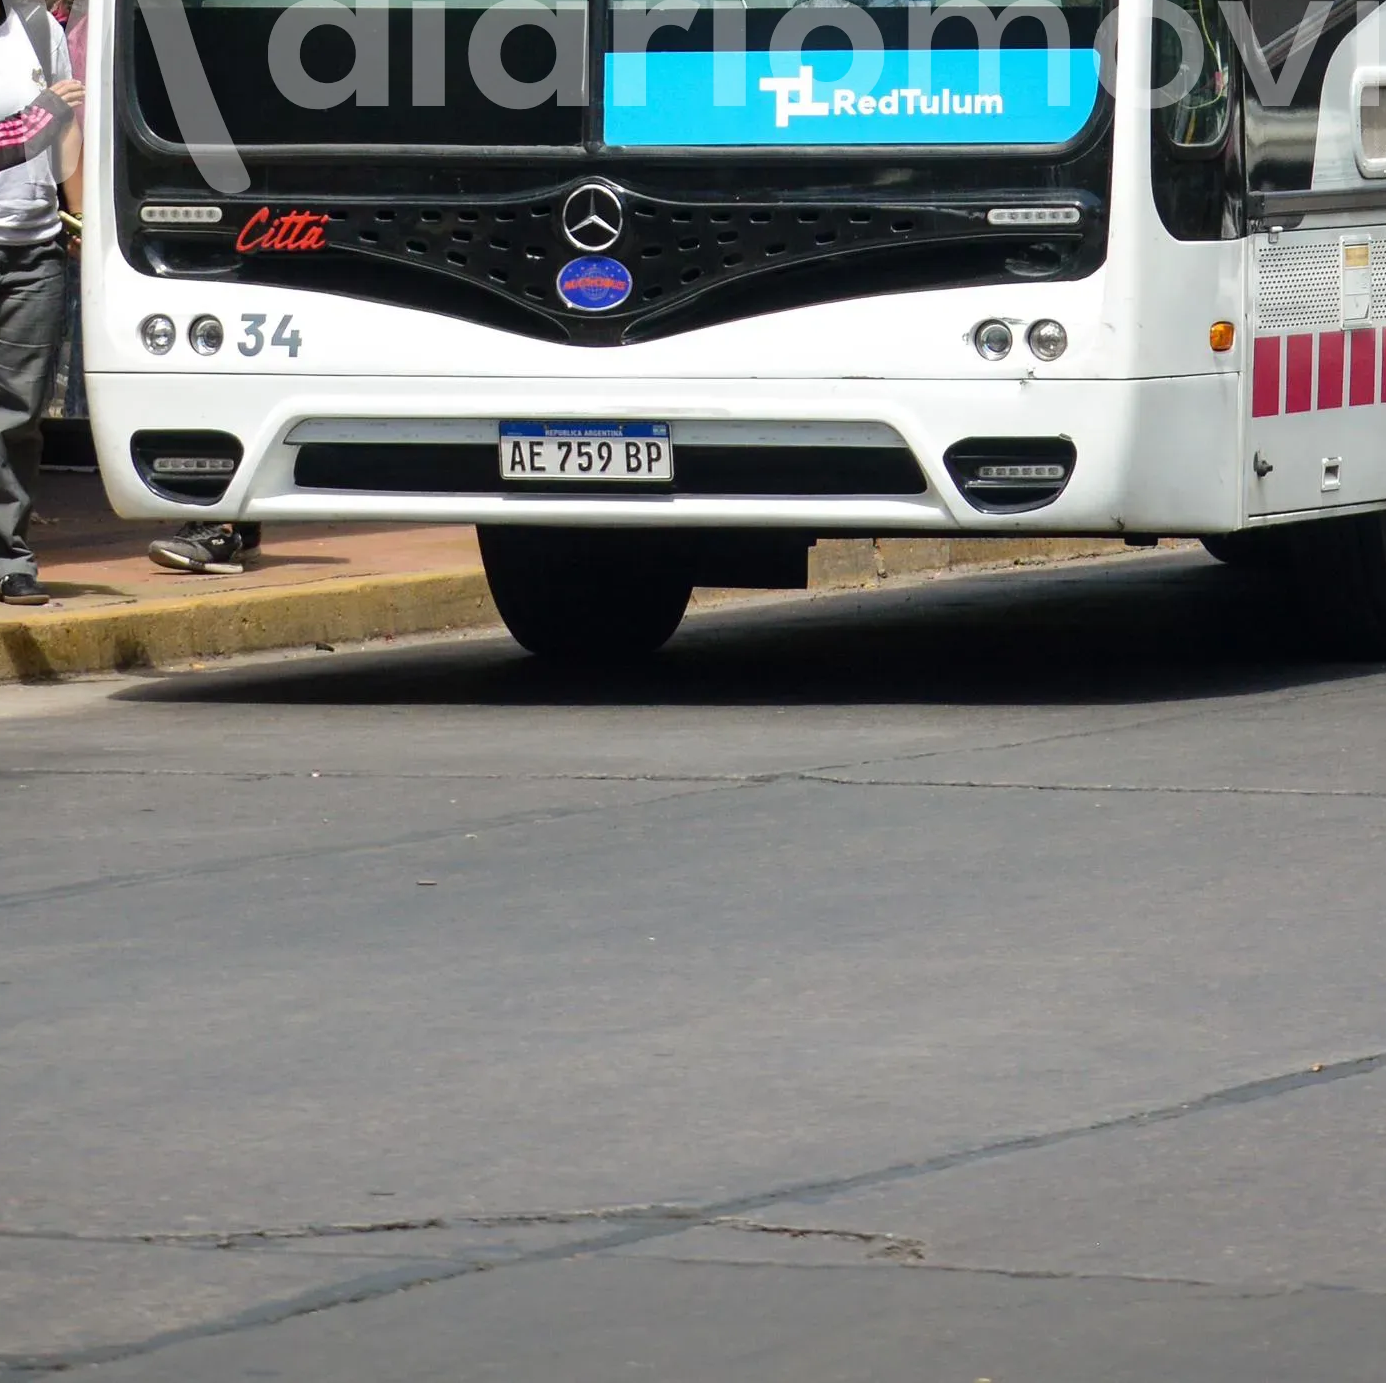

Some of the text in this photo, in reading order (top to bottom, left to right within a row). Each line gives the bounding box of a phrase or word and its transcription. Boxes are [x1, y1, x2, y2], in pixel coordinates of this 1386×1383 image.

[834, 89, 1003, 115] RedTulum
[237, 313, 302, 357] 34
[584, 429, 623, 437] ARGENTINA
[510, 441, 662, 473] AE 759 BP
